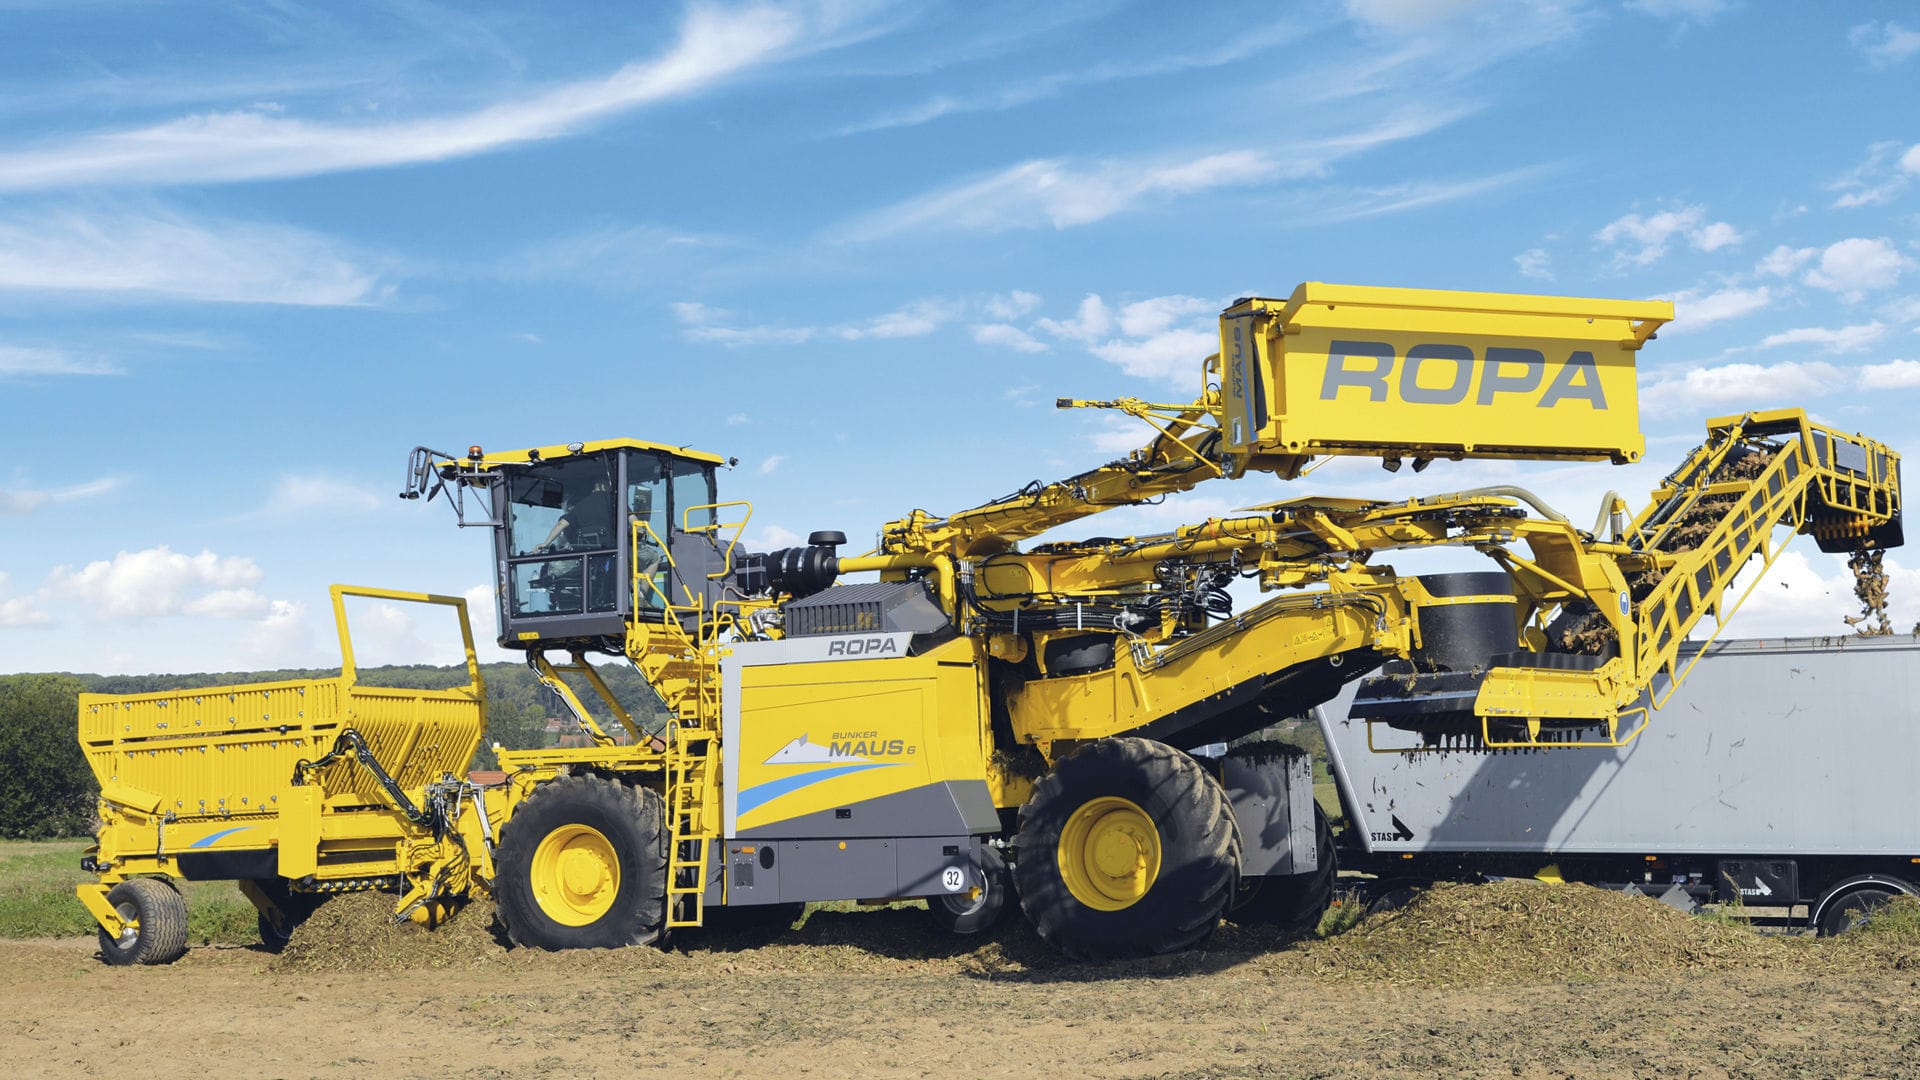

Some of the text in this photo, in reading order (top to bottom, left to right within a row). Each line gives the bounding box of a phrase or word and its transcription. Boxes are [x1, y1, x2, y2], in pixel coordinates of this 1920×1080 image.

[1233, 327, 1242, 399] MAUS
[1319, 340, 1609, 410] ROPA
[500, 560, 508, 615] MAUS
[828, 637, 897, 656] ROPA
[832, 731, 878, 740] BUNKER
[828, 739, 916, 757] MAUS 6
[1371, 832, 1392, 842] STAS
[946, 871, 960, 886] 32
